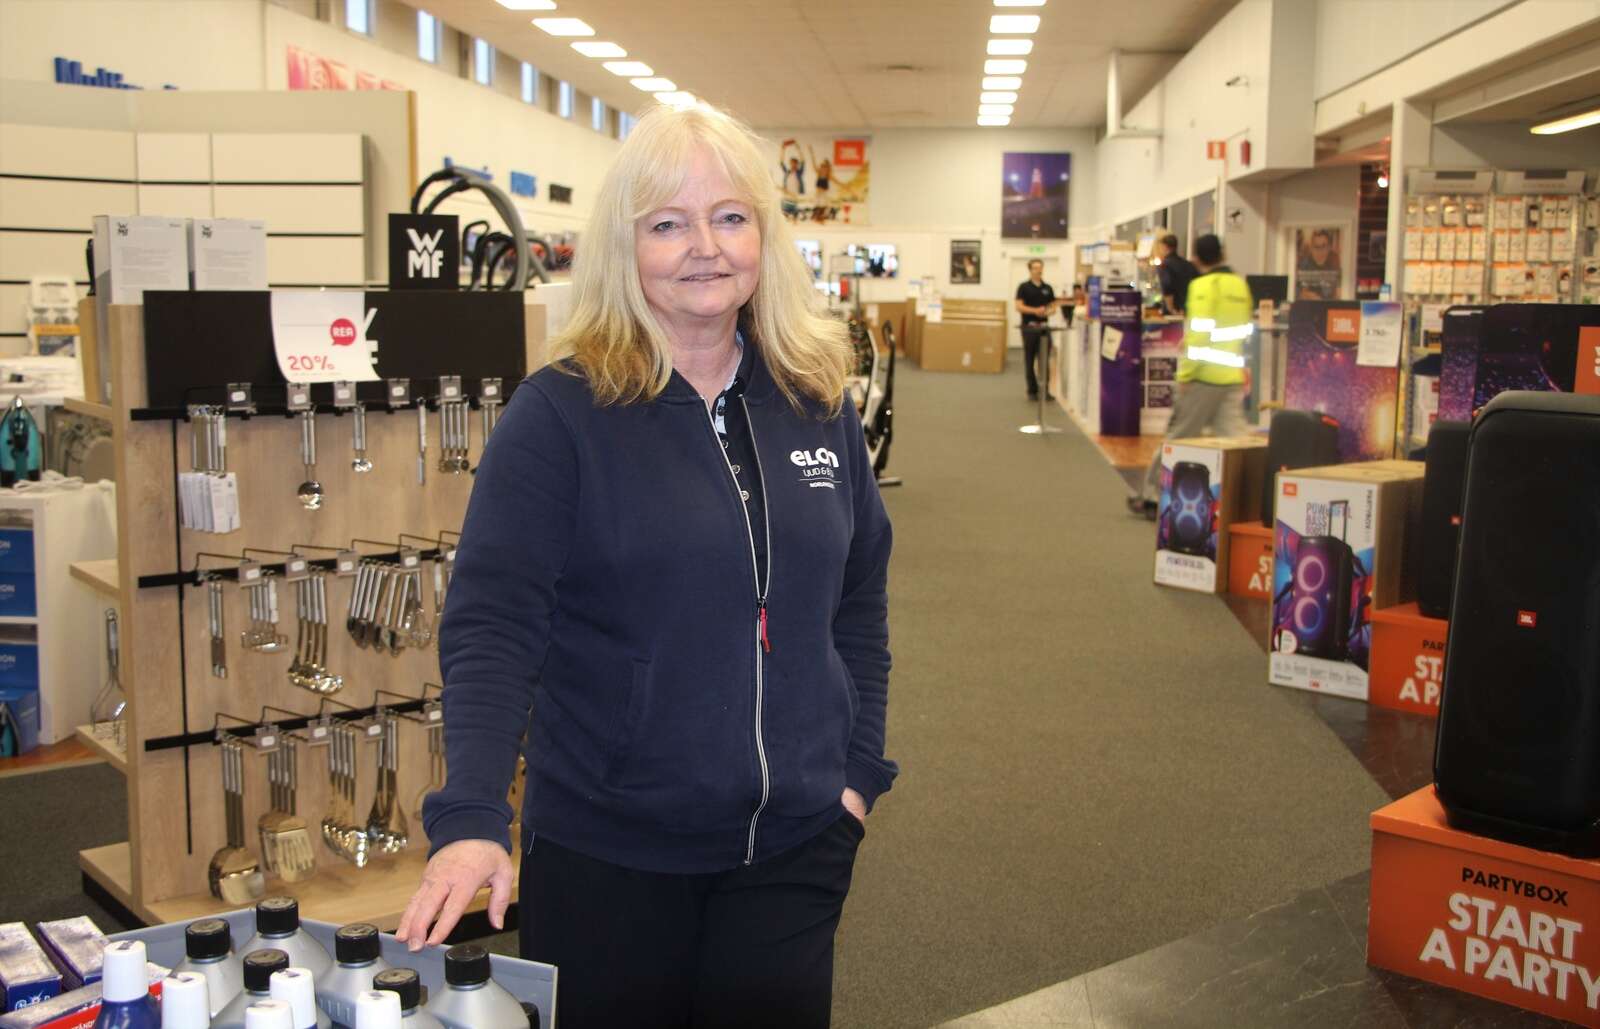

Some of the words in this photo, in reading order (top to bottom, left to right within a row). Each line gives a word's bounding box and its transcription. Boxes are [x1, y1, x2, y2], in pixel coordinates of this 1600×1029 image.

[332, 326, 353, 337] REA
[287, 355, 335, 371] 20%
[1461, 867, 1568, 906] PARTYBOX
[1448, 892, 1582, 960] START
[1418, 927, 1456, 970] A
[1464, 936, 1600, 1010] PARTY
